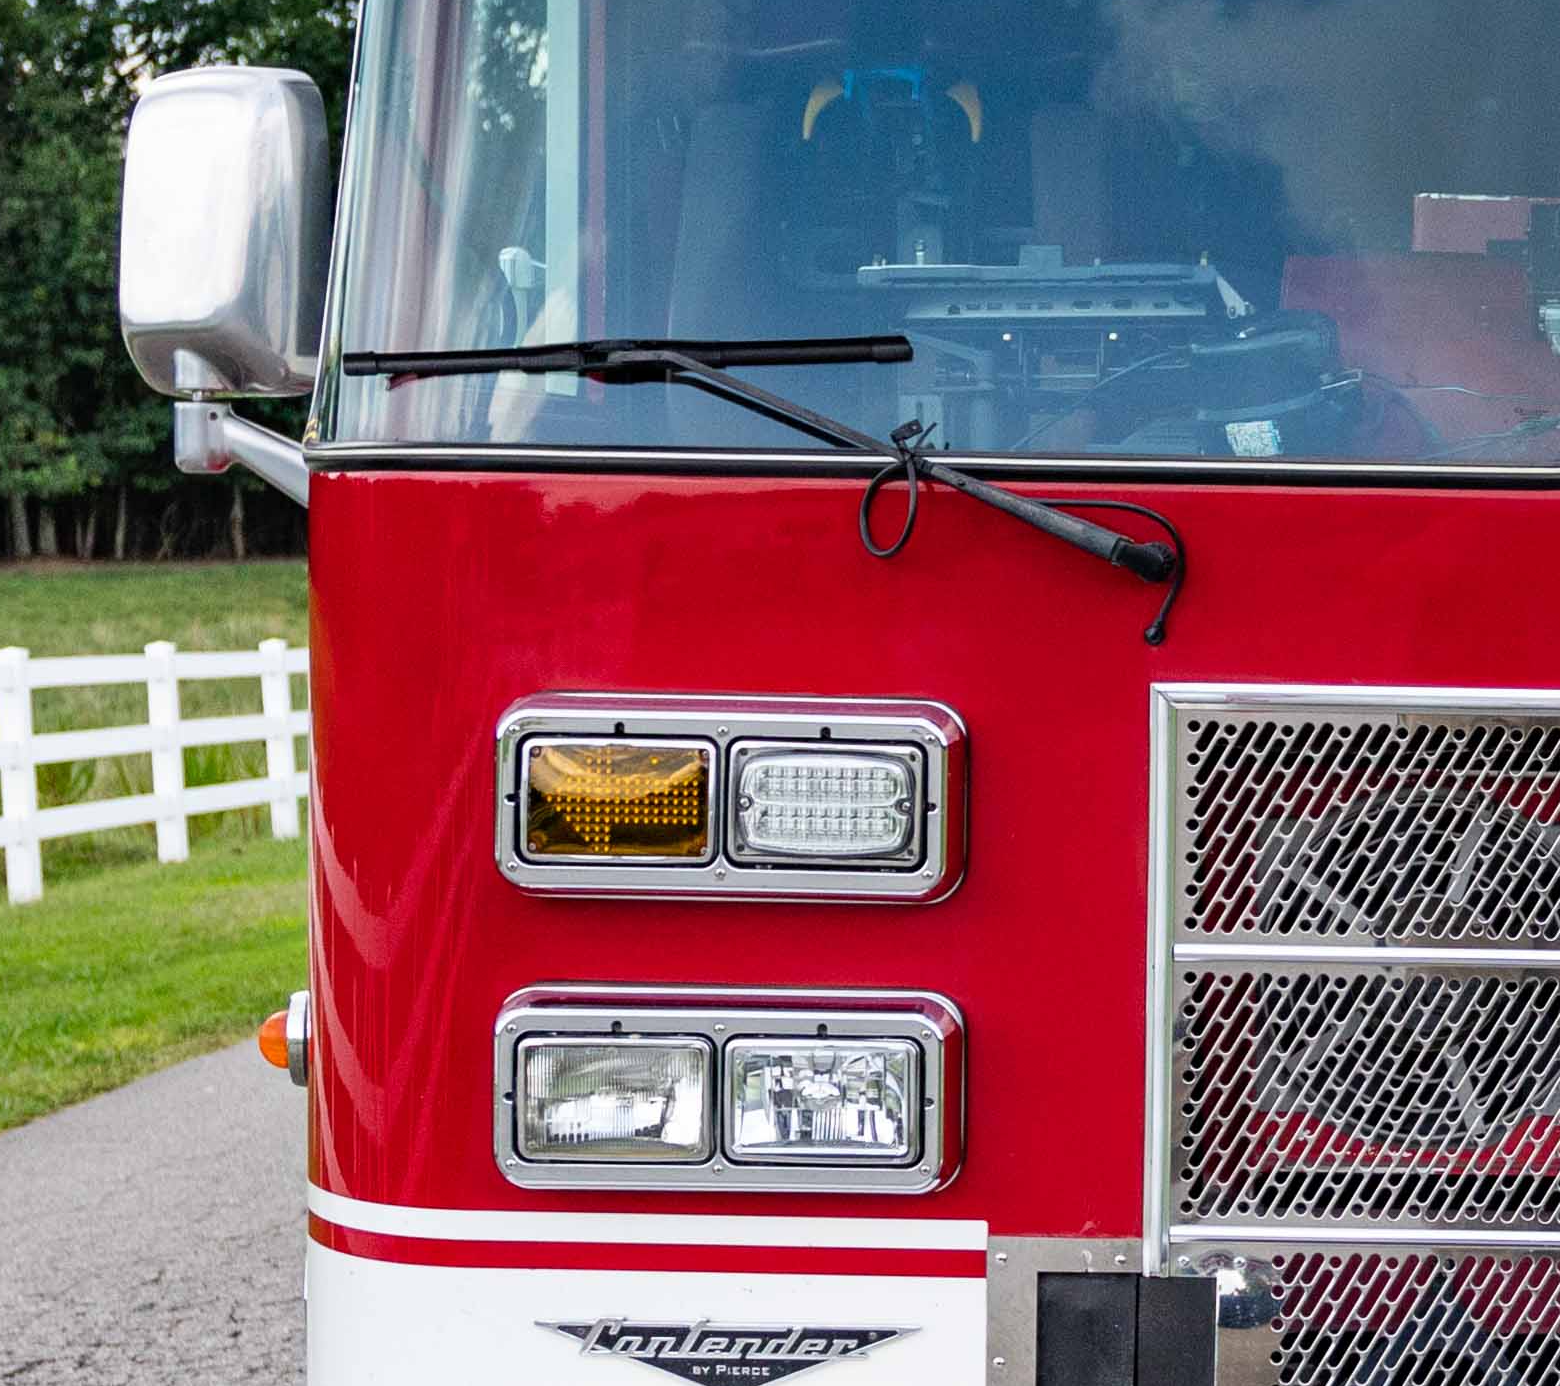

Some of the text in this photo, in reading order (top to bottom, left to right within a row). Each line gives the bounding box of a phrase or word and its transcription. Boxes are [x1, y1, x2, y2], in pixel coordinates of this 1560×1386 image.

[580, 1317, 867, 1360] Contender
[692, 1364, 771, 1376] BY PIERCE
